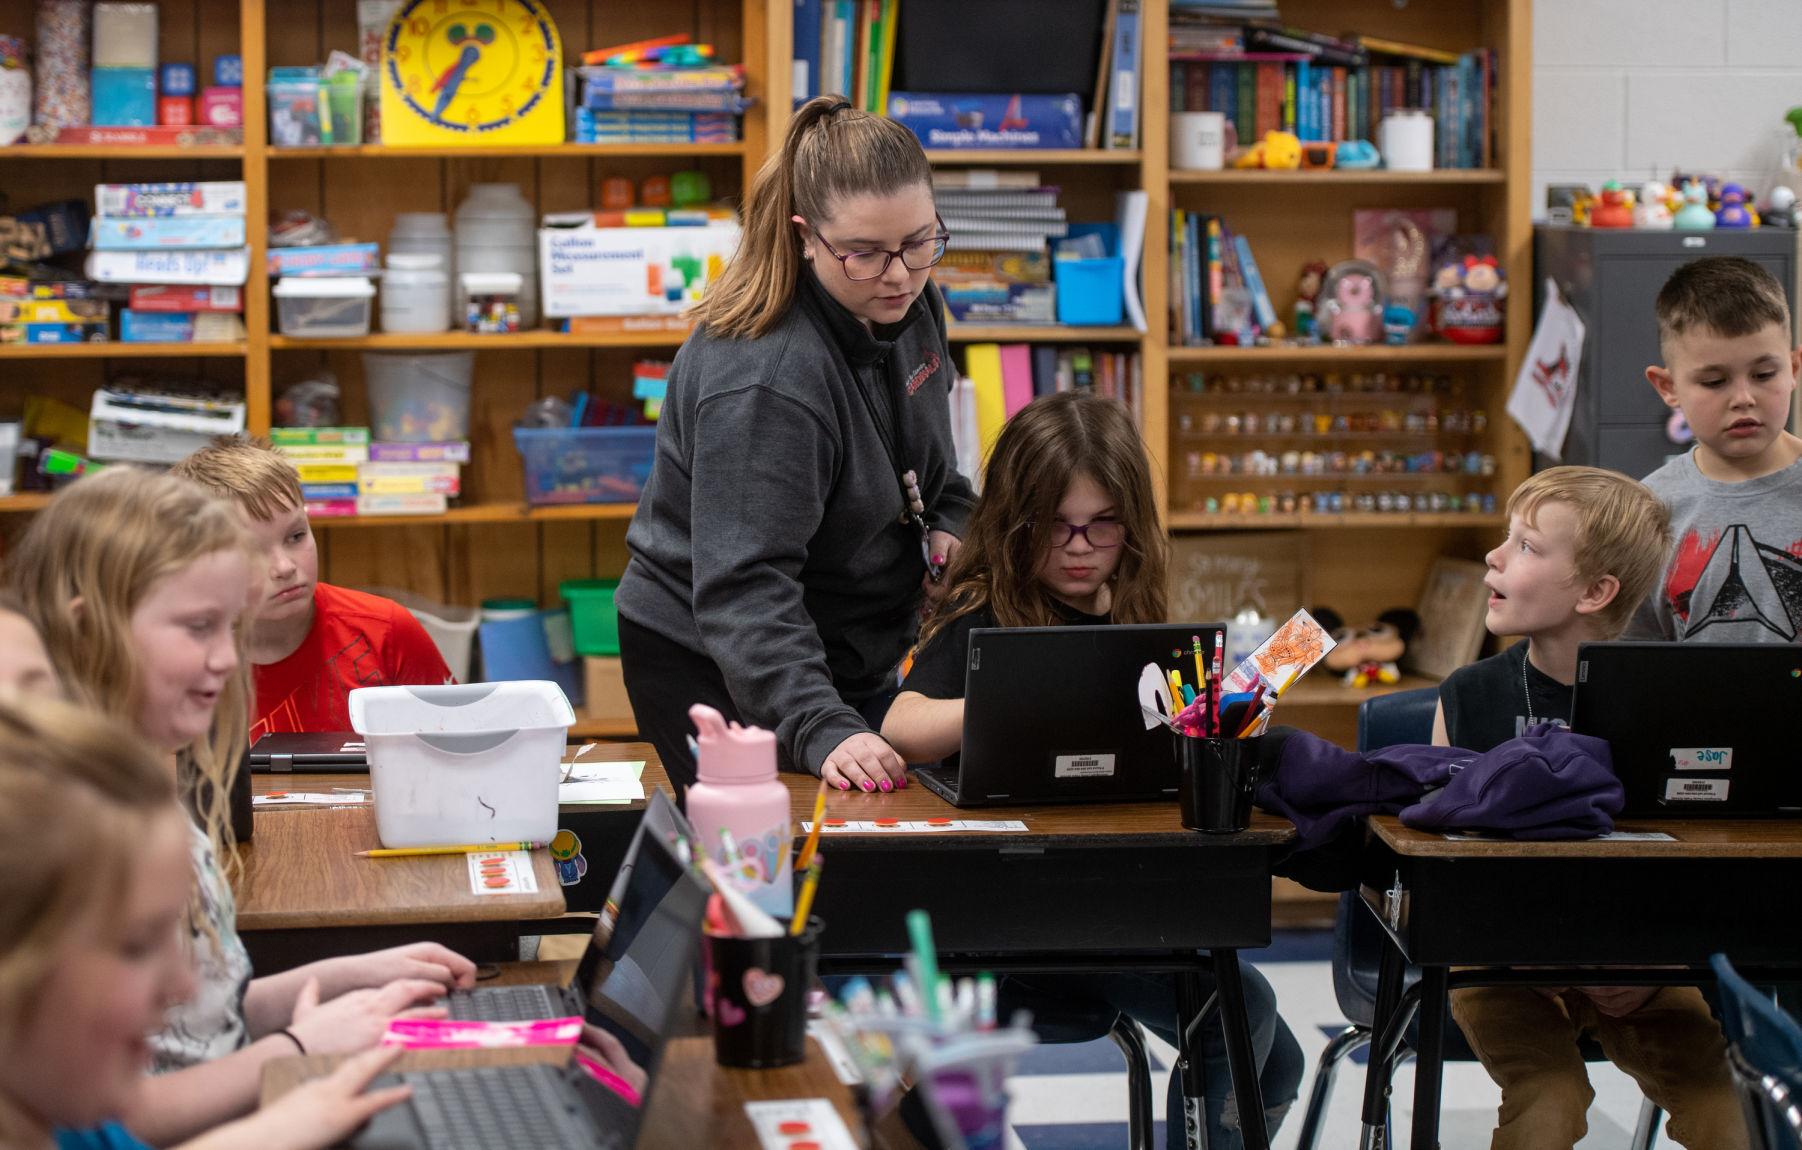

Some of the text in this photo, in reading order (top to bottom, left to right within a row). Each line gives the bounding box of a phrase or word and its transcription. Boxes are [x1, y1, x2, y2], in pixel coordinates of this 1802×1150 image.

[408, 16, 430, 36] 10
[929, 130, 1040, 147] Simple Machines
[551, 250, 643, 262] Measurement
[552, 264, 573, 274] Set
[1696, 749, 1728, 764] Jase
